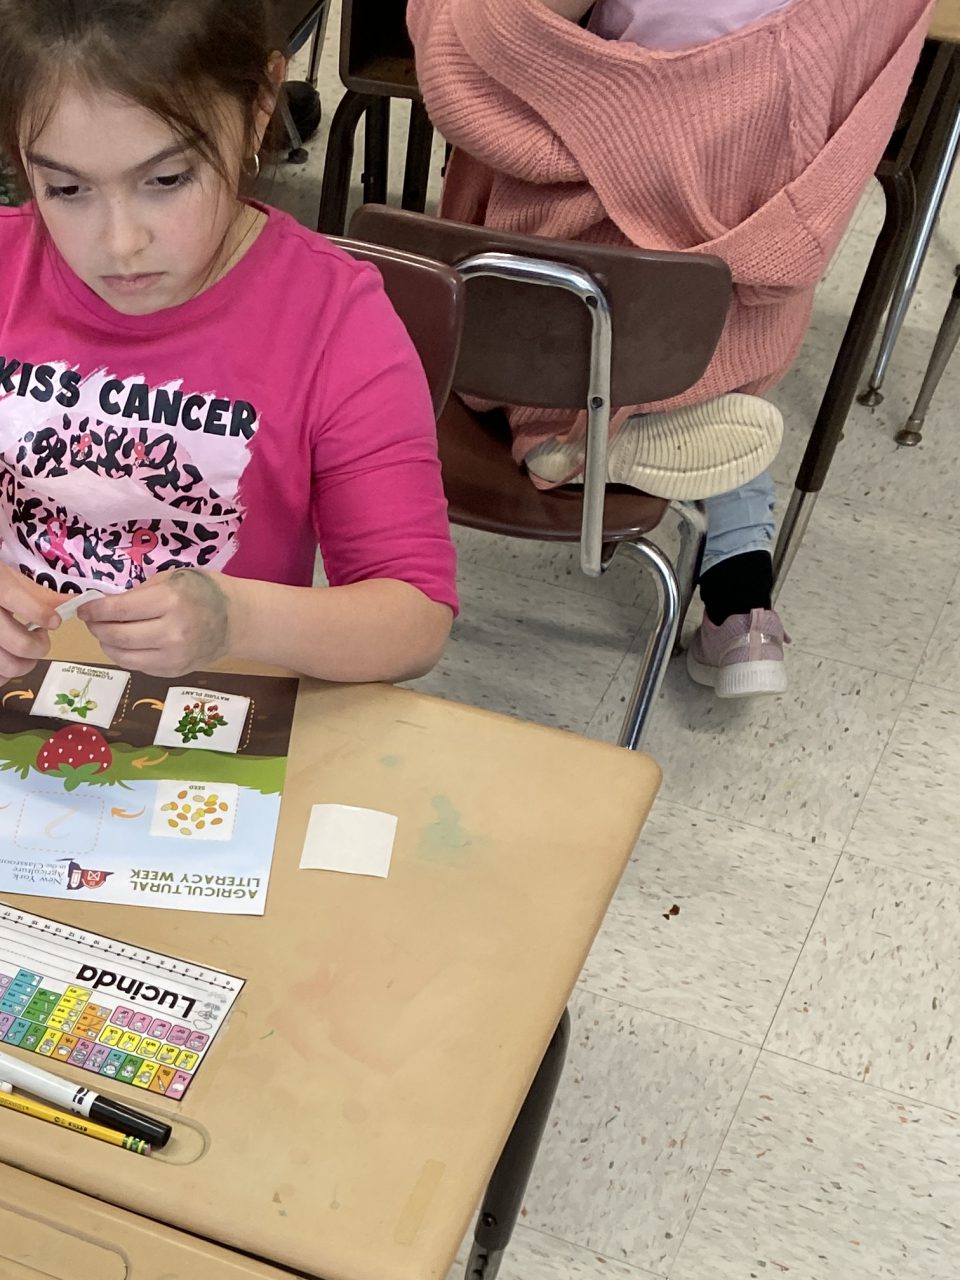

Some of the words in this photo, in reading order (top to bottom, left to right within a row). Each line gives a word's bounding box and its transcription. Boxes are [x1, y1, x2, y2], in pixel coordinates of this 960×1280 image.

[98, 378, 259, 441] CANCER
[12, 866, 65, 879] Agriculture
[12, 873, 37, 883] York
[129, 868, 175, 882] WEEK
[40, 875, 62, 886] New
[180, 873, 261, 888] LITERACY
[130, 880, 258, 899] AGRICULTURAL
[76, 964, 197, 1019] Lucinda
